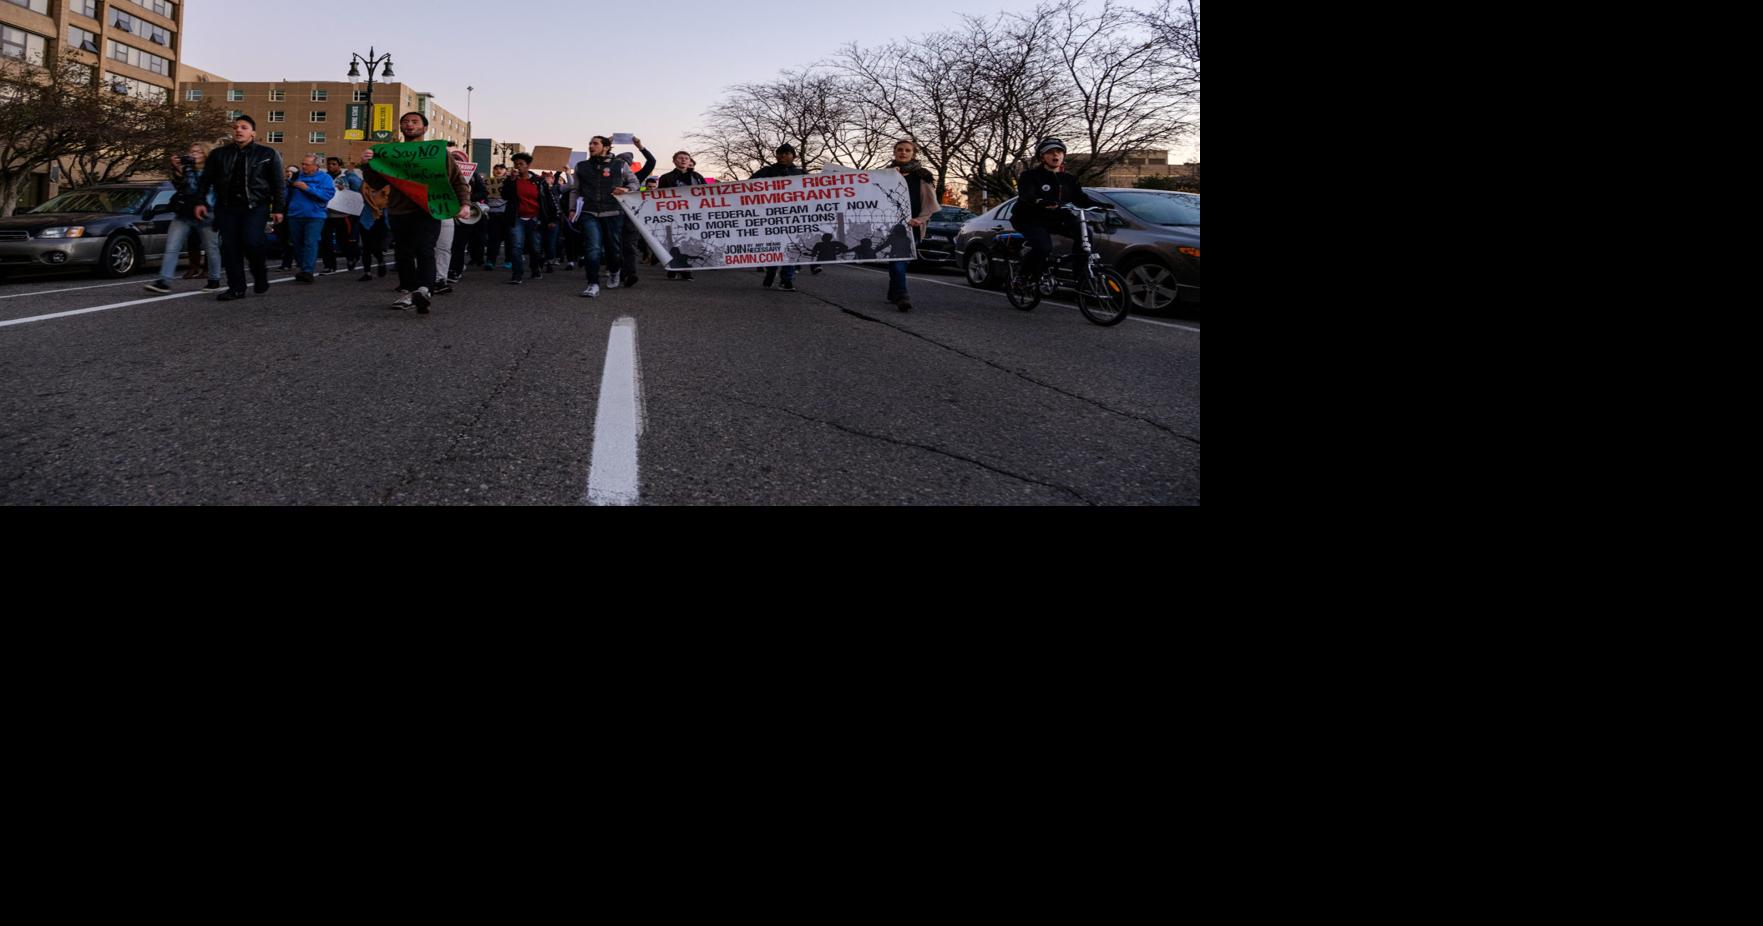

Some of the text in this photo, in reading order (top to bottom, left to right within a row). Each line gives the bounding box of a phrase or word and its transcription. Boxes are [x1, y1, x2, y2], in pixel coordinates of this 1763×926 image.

[372, 145, 440, 162] We Say NO
[641, 173, 870, 201] FULL CITIZENSHIP RIGHTS
[656, 187, 856, 212] FOR ALL IMMIGRANTS
[644, 200, 879, 224] PASS THE FEDERAL DREAM ACT NOW
[684, 212, 835, 231] NO MORE DEPORTATIONS
[700, 224, 820, 239] OPEN THE BORDERS
[724, 244, 747, 254] JOIN
[725, 252, 784, 264] BAMN.COM
